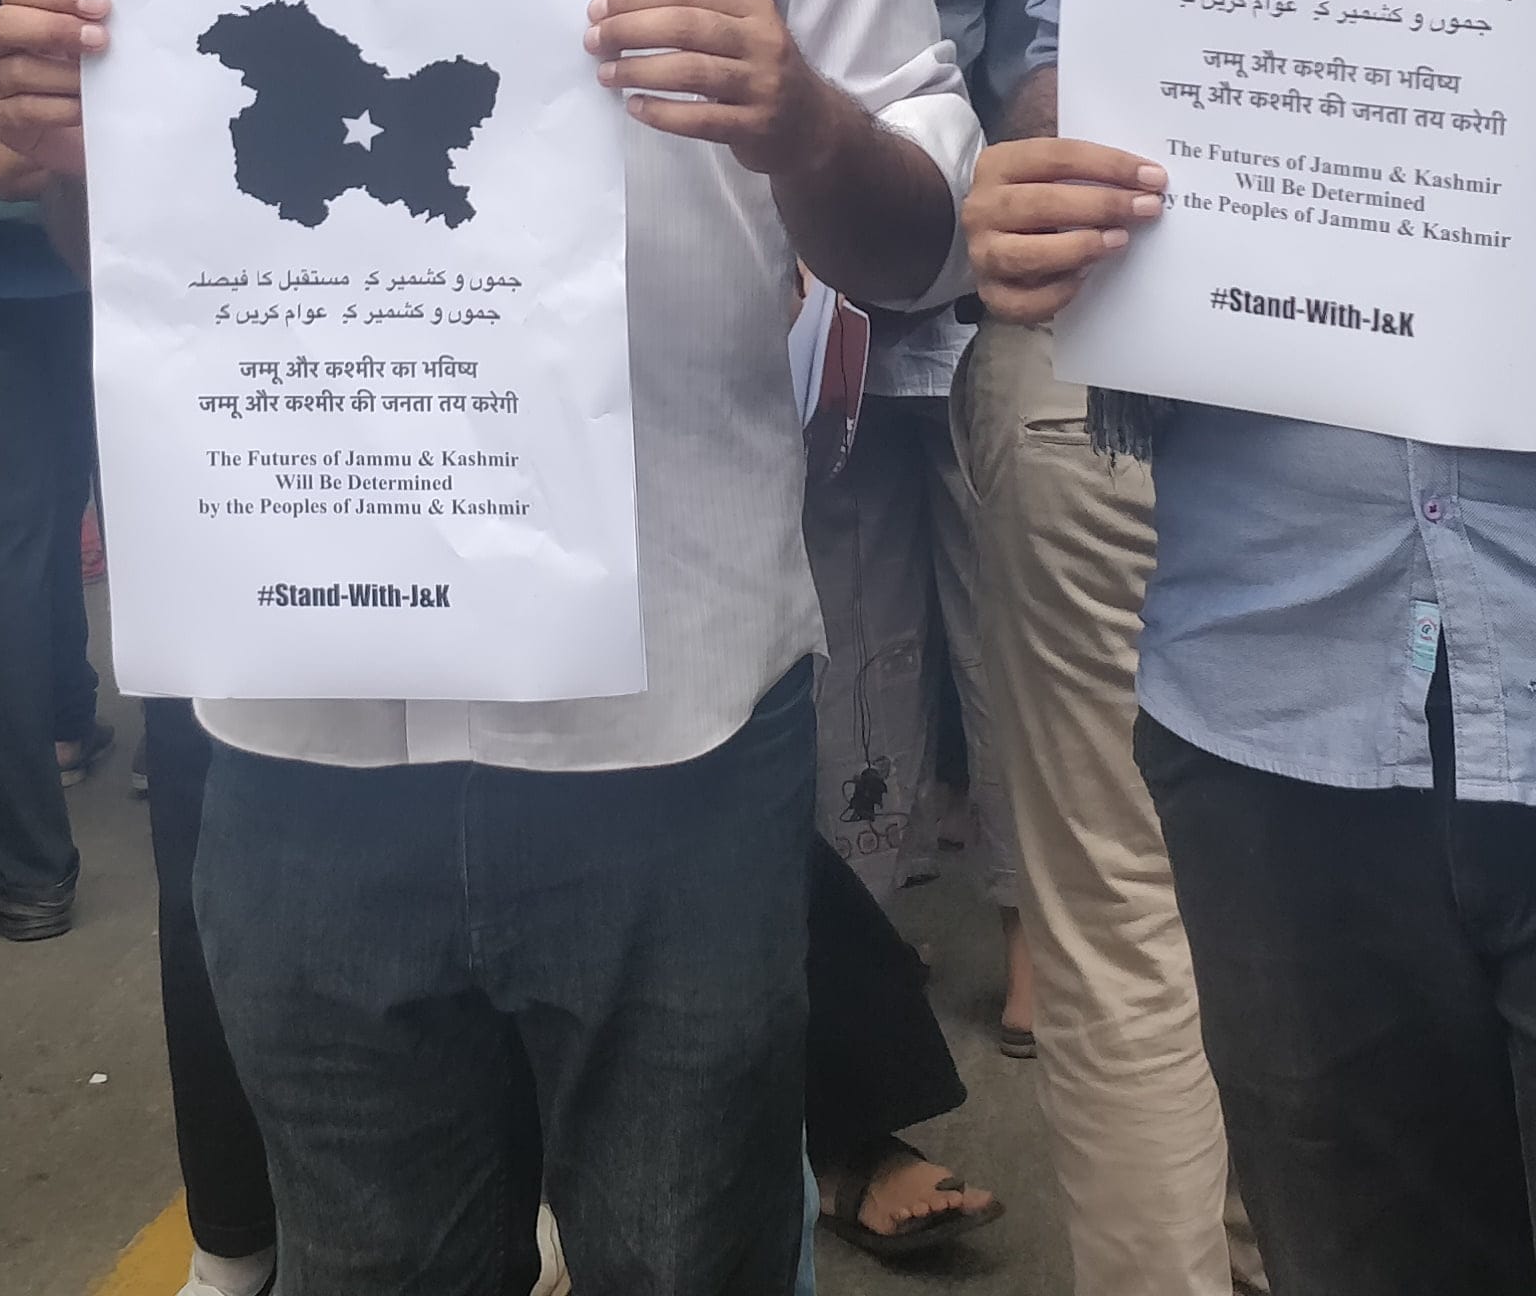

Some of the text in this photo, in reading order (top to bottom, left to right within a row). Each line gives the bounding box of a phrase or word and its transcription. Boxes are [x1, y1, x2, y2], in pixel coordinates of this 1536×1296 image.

[1202, 49, 1463, 95] जम्मू और कश्मीर का भविष्य
[1159, 80, 1508, 137] जम्मू और कश्मीर की जनता तय करेगी
[1166, 138, 1503, 195] The Futures of Jammu & Kashmir
[1234, 172, 1426, 212] Will Be Determined
[1183, 191, 1213, 211] the
[1218, 195, 1289, 222] Peoples
[1294, 206, 1316, 224] of
[1317, 208, 1391, 234] Jammu
[1396, 218, 1415, 237] &
[1422, 221, 1513, 249] Kashmir
[256, 270, 273, 287] کا
[278, 268, 350, 292] مستقبل
[284, 303, 328, 328] عوام
[238, 354, 479, 386] जम्मू और कश्मीर का भविष्य
[197, 388, 520, 420] जम्मू और कश्मीर की जनता तय करेगी
[205, 449, 520, 468] The Futures of Jammu & Kashmir
[274, 473, 453, 491] Will Be Determined
[198, 497, 531, 519] by the Peoples of Jammu & Kashmir
